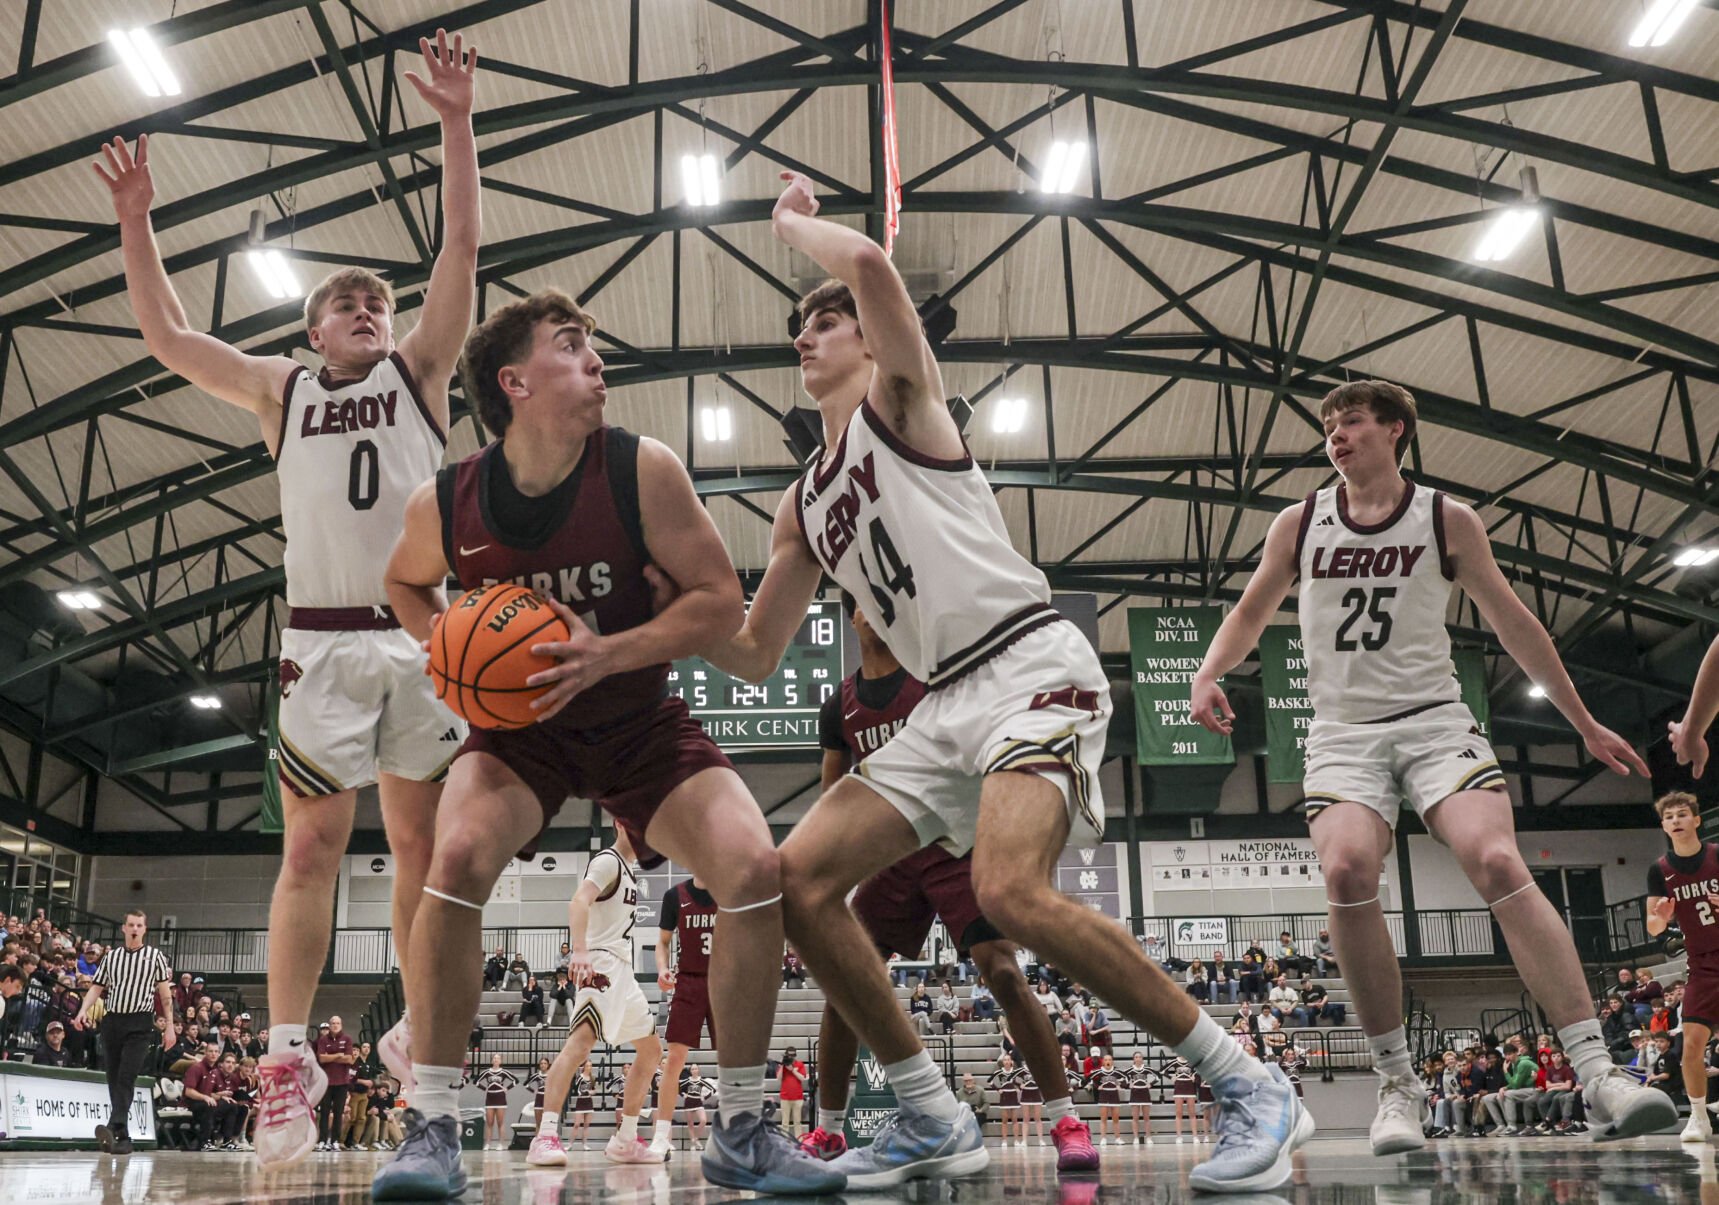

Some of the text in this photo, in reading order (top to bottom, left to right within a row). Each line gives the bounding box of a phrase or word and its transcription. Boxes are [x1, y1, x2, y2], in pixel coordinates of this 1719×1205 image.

[301, 390, 398, 439] LEROY
[348, 439, 380, 511] 0
[1311, 545, 1427, 579] LEROY
[482, 561, 613, 603] RKS
[1157, 616, 1195, 628] NCAA
[1335, 587, 1397, 652] 25
[811, 618, 834, 645] 18
[1154, 630, 1199, 642] DIV. III
[1146, 657, 1205, 670] WOMEN'
[694, 686, 707, 706] 5
[784, 684, 798, 705] 5
[1153, 699, 1192, 712] FOUR
[702, 719, 749, 737] HIRK
[1160, 714, 1201, 726] PLAC
[854, 718, 905, 753] TURK
[1172, 742, 1198, 754] 2011
[1239, 842, 1297, 852] NATIONAL
[1221, 850, 1317, 862] HALL OF FAMERS
[1673, 878, 1719, 902] TURKS
[685, 913, 718, 929] TURK
[1198, 922, 1223, 930] TITAN
[1200, 932, 1223, 940] BAND
[36, 1098, 66, 1118] HOME
[69, 1101, 81, 1119] OF
[84, 1102, 102, 1120] THE
[857, 1110, 897, 1120] ILLINO
